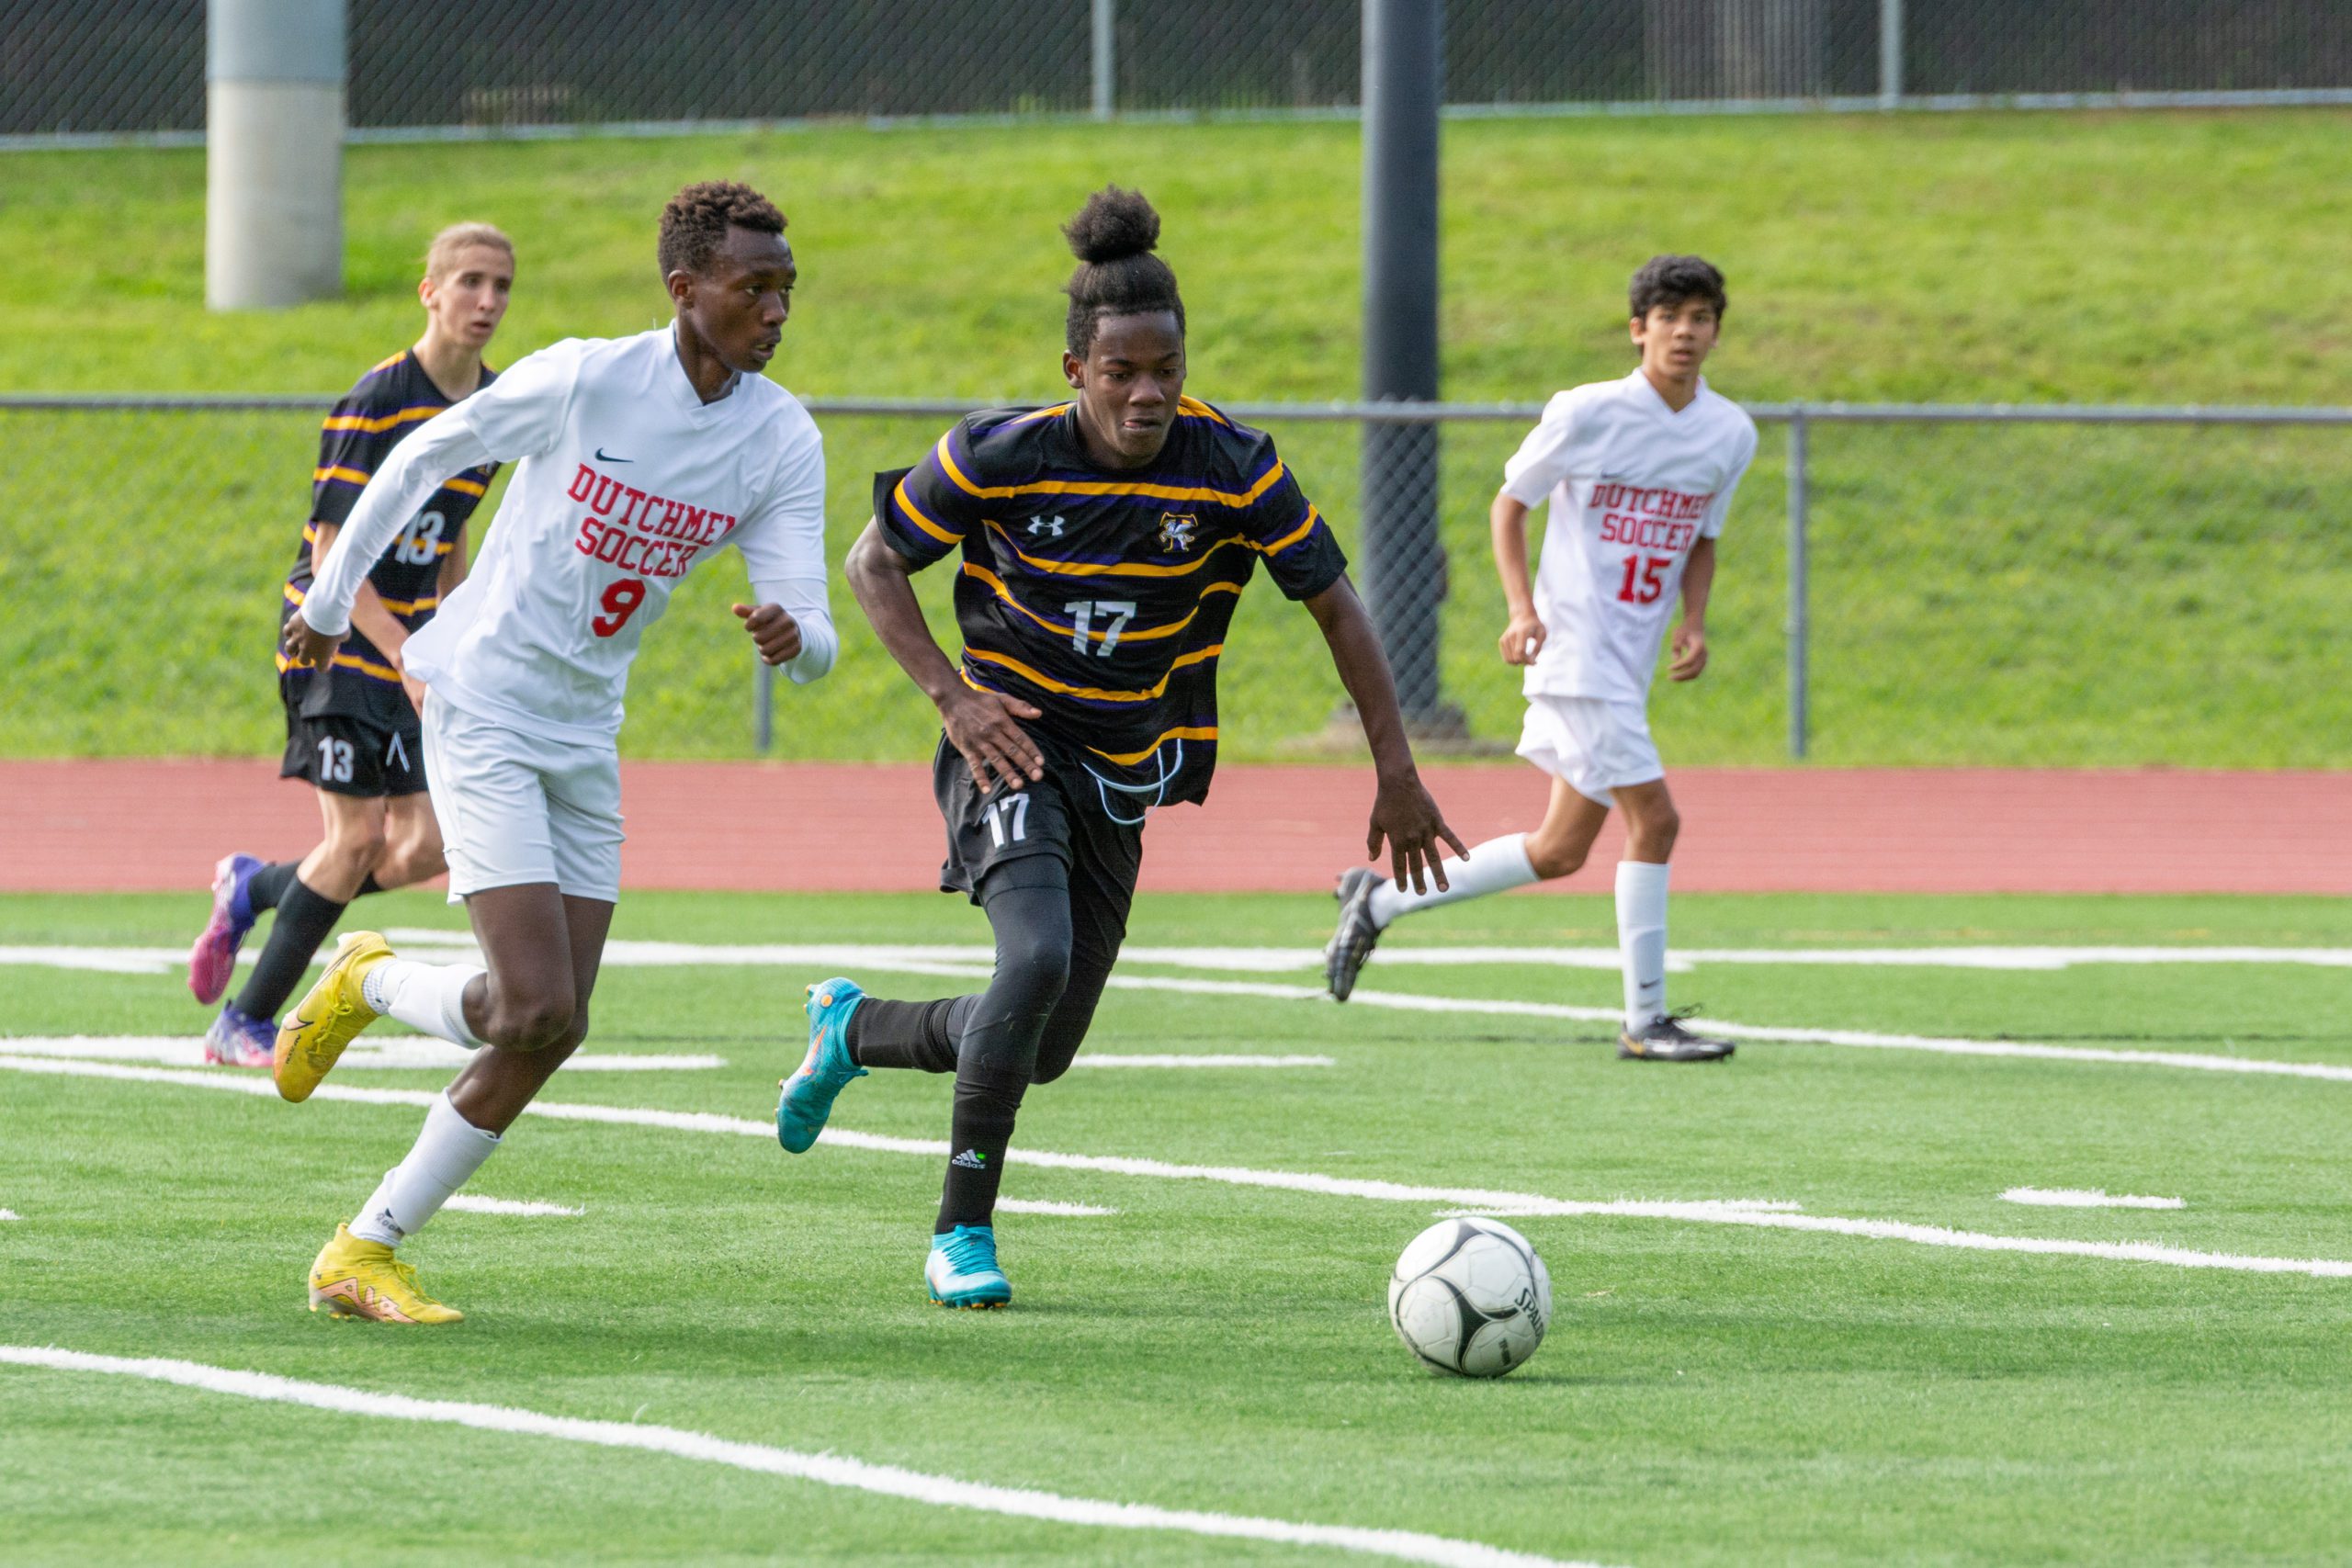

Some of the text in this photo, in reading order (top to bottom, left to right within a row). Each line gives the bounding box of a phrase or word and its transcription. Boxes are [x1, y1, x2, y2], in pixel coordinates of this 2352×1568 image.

[395, 511, 446, 566] 13
[574, 516, 699, 578] SOCCER
[1599, 513, 1695, 553] SOCCER
[1617, 554, 1671, 604] 15
[591, 578, 646, 637] 9
[1064, 601, 1136, 657] 17
[318, 735, 354, 783] 13
[981, 793, 1030, 848] 17
[1513, 1287, 1544, 1344] SPALD
